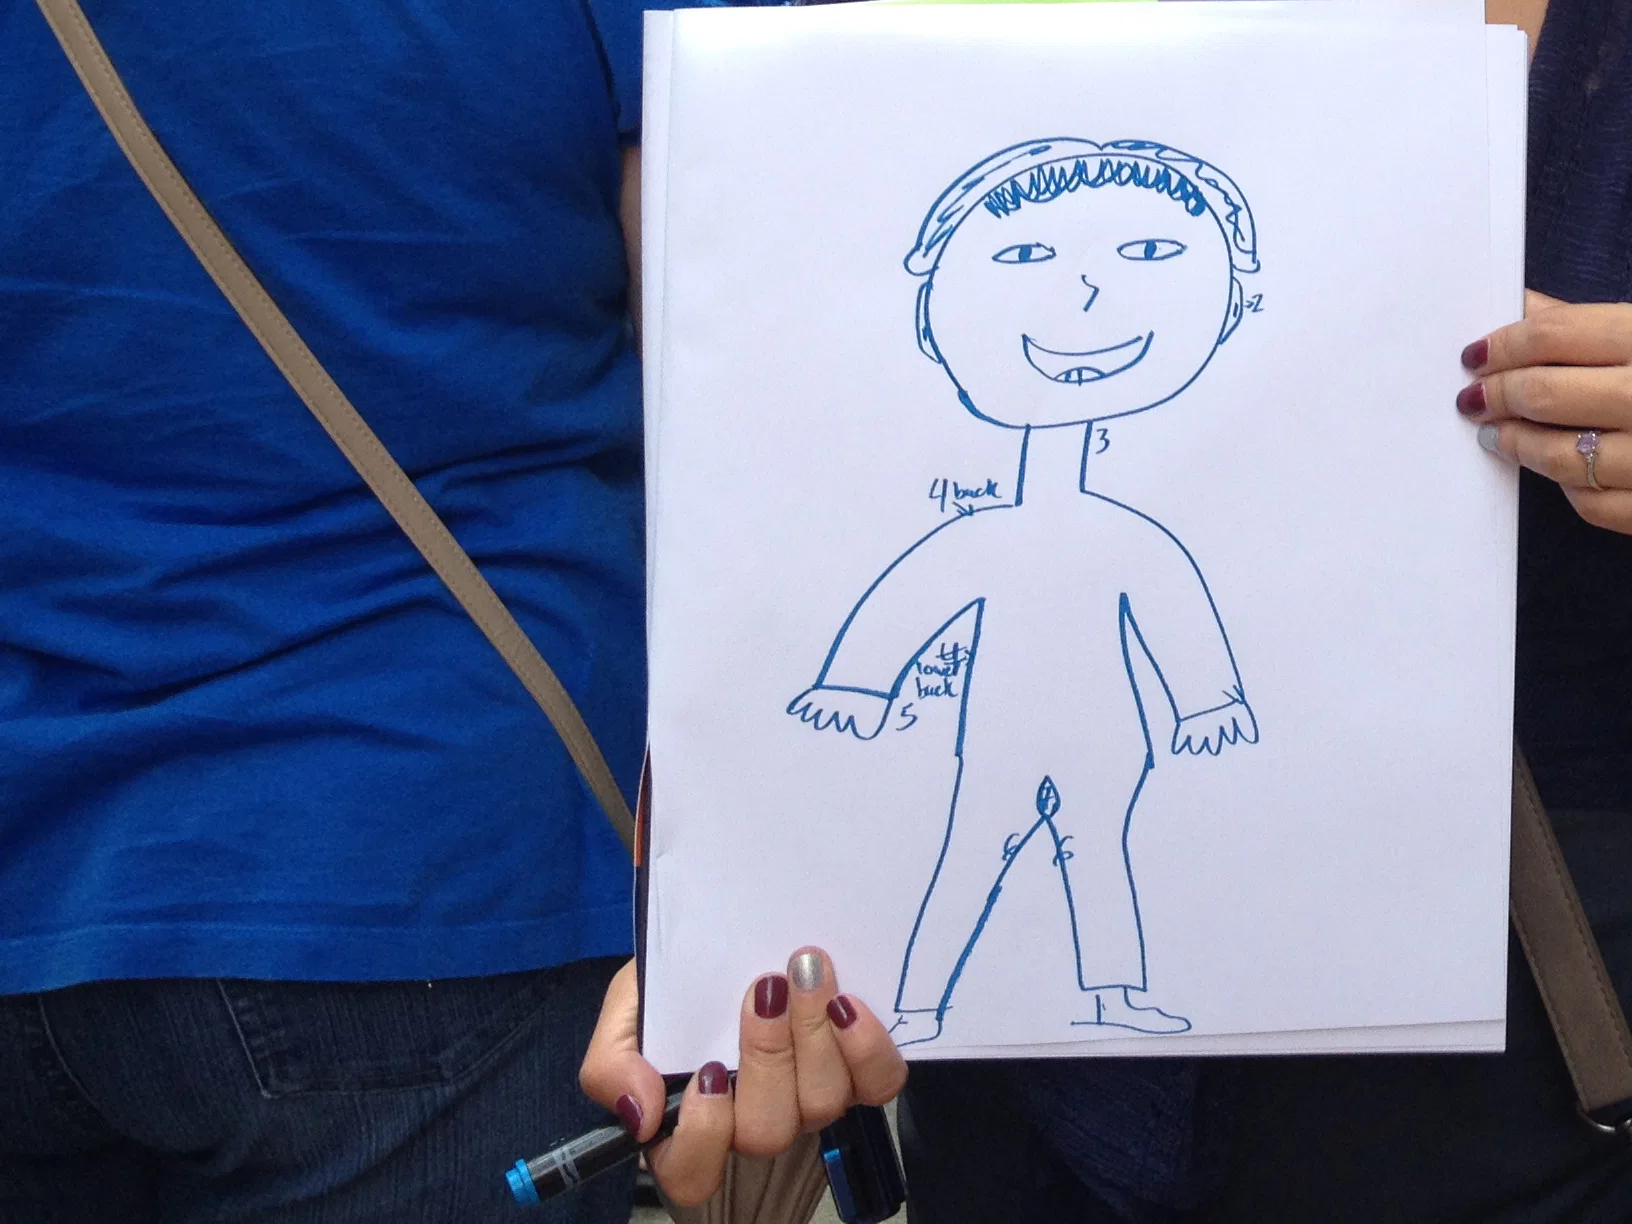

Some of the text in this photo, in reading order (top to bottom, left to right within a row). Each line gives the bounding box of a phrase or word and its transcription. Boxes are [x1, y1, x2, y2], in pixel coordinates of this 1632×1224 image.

[1095, 428, 1110, 454] 3
[929, 478, 1002, 512] 4 back
[895, 702, 918, 731] 5
